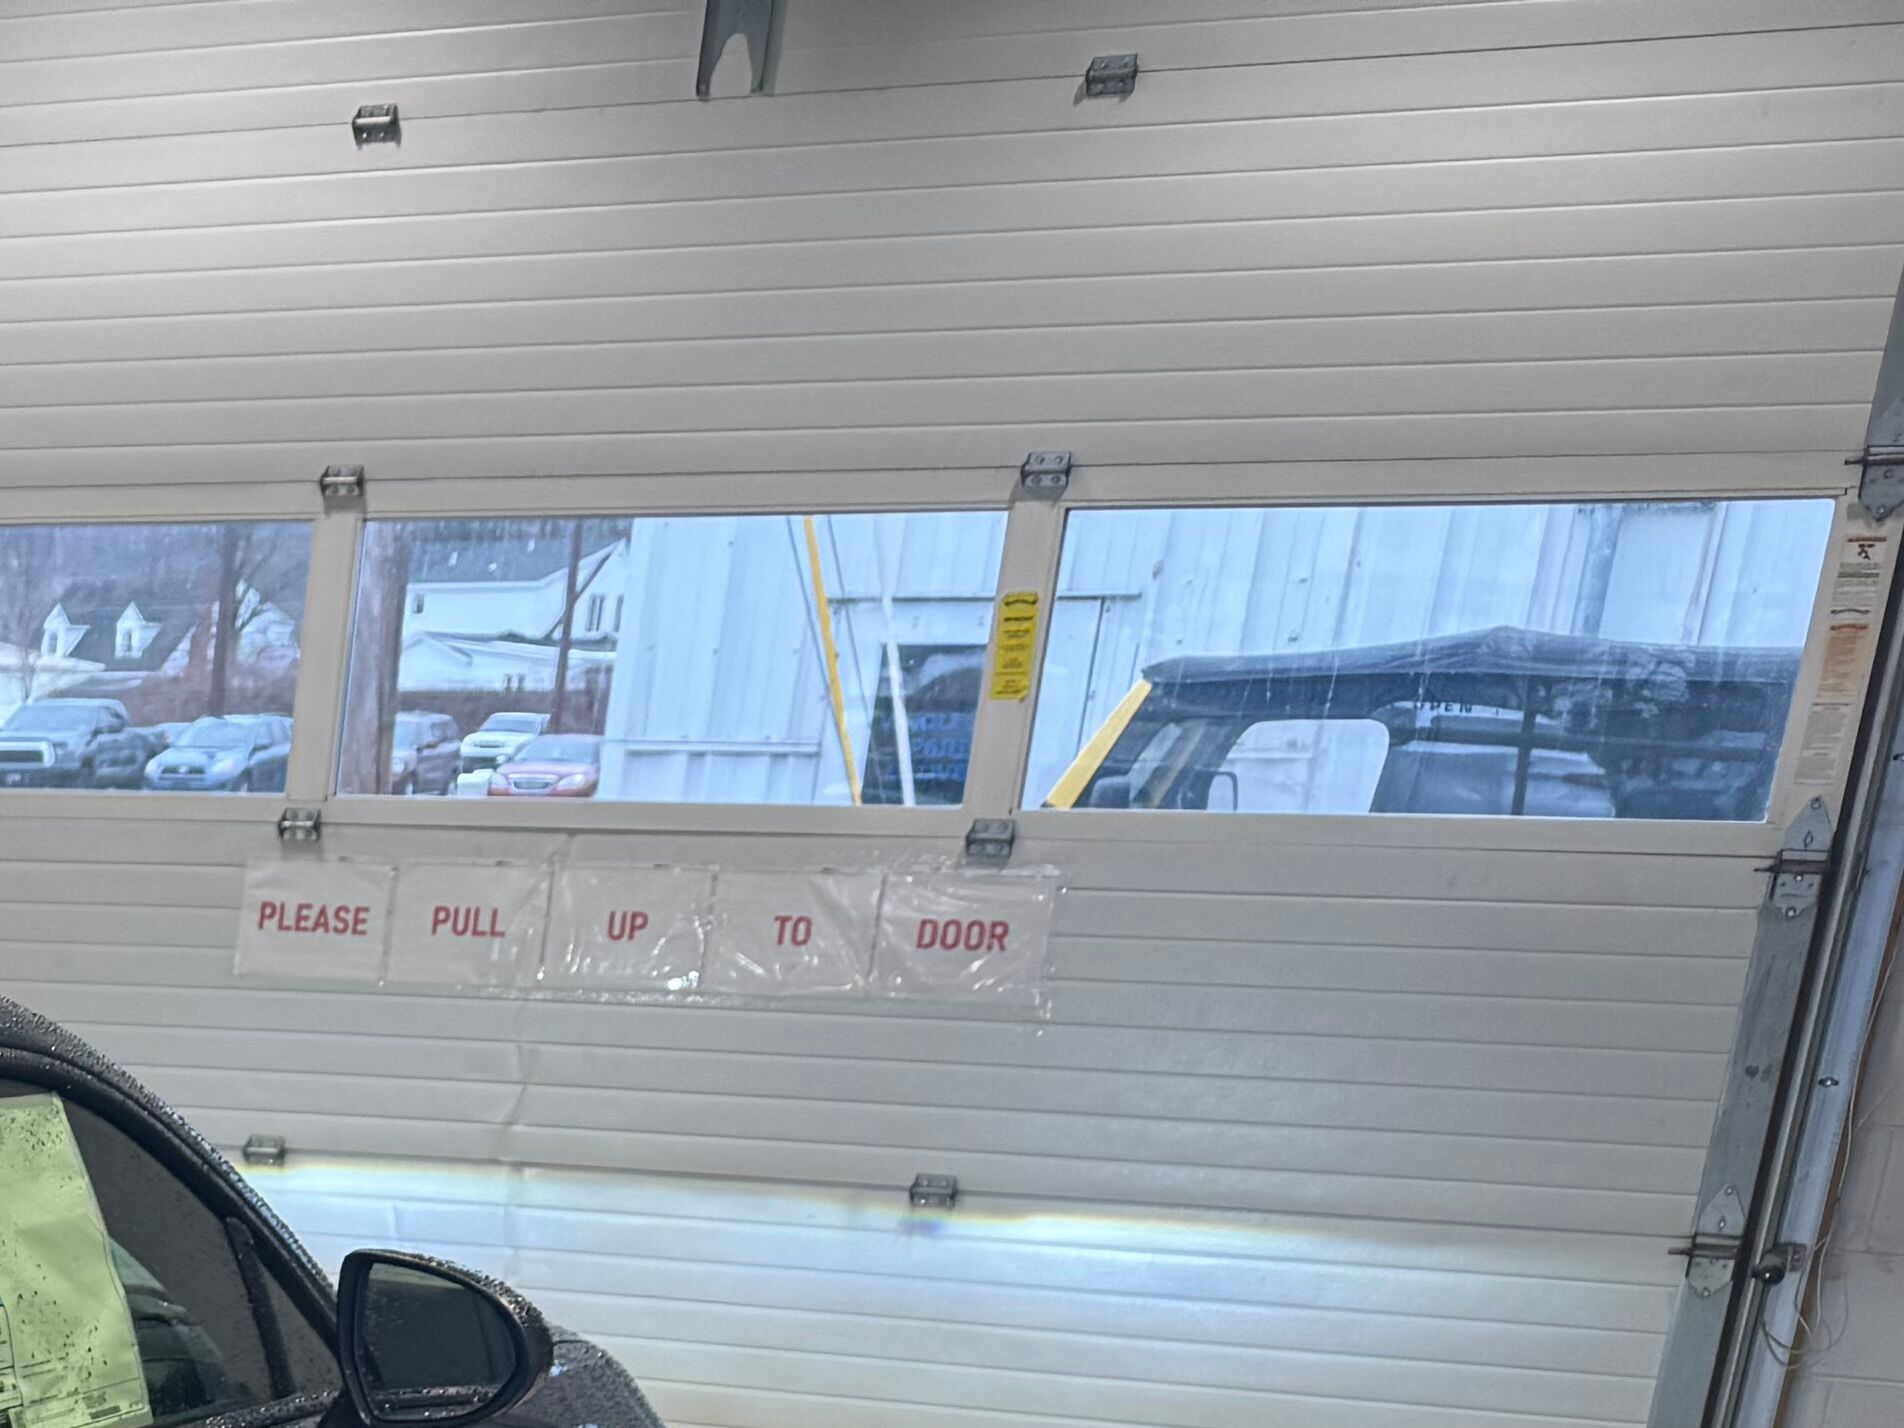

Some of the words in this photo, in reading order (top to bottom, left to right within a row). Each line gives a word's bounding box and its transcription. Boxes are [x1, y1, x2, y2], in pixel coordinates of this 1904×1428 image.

[257, 901, 369, 936] PLEASE
[431, 905, 506, 938] PULL
[606, 910, 649, 942] UP
[773, 915, 813, 947] TO
[915, 918, 1010, 953] DOOR
